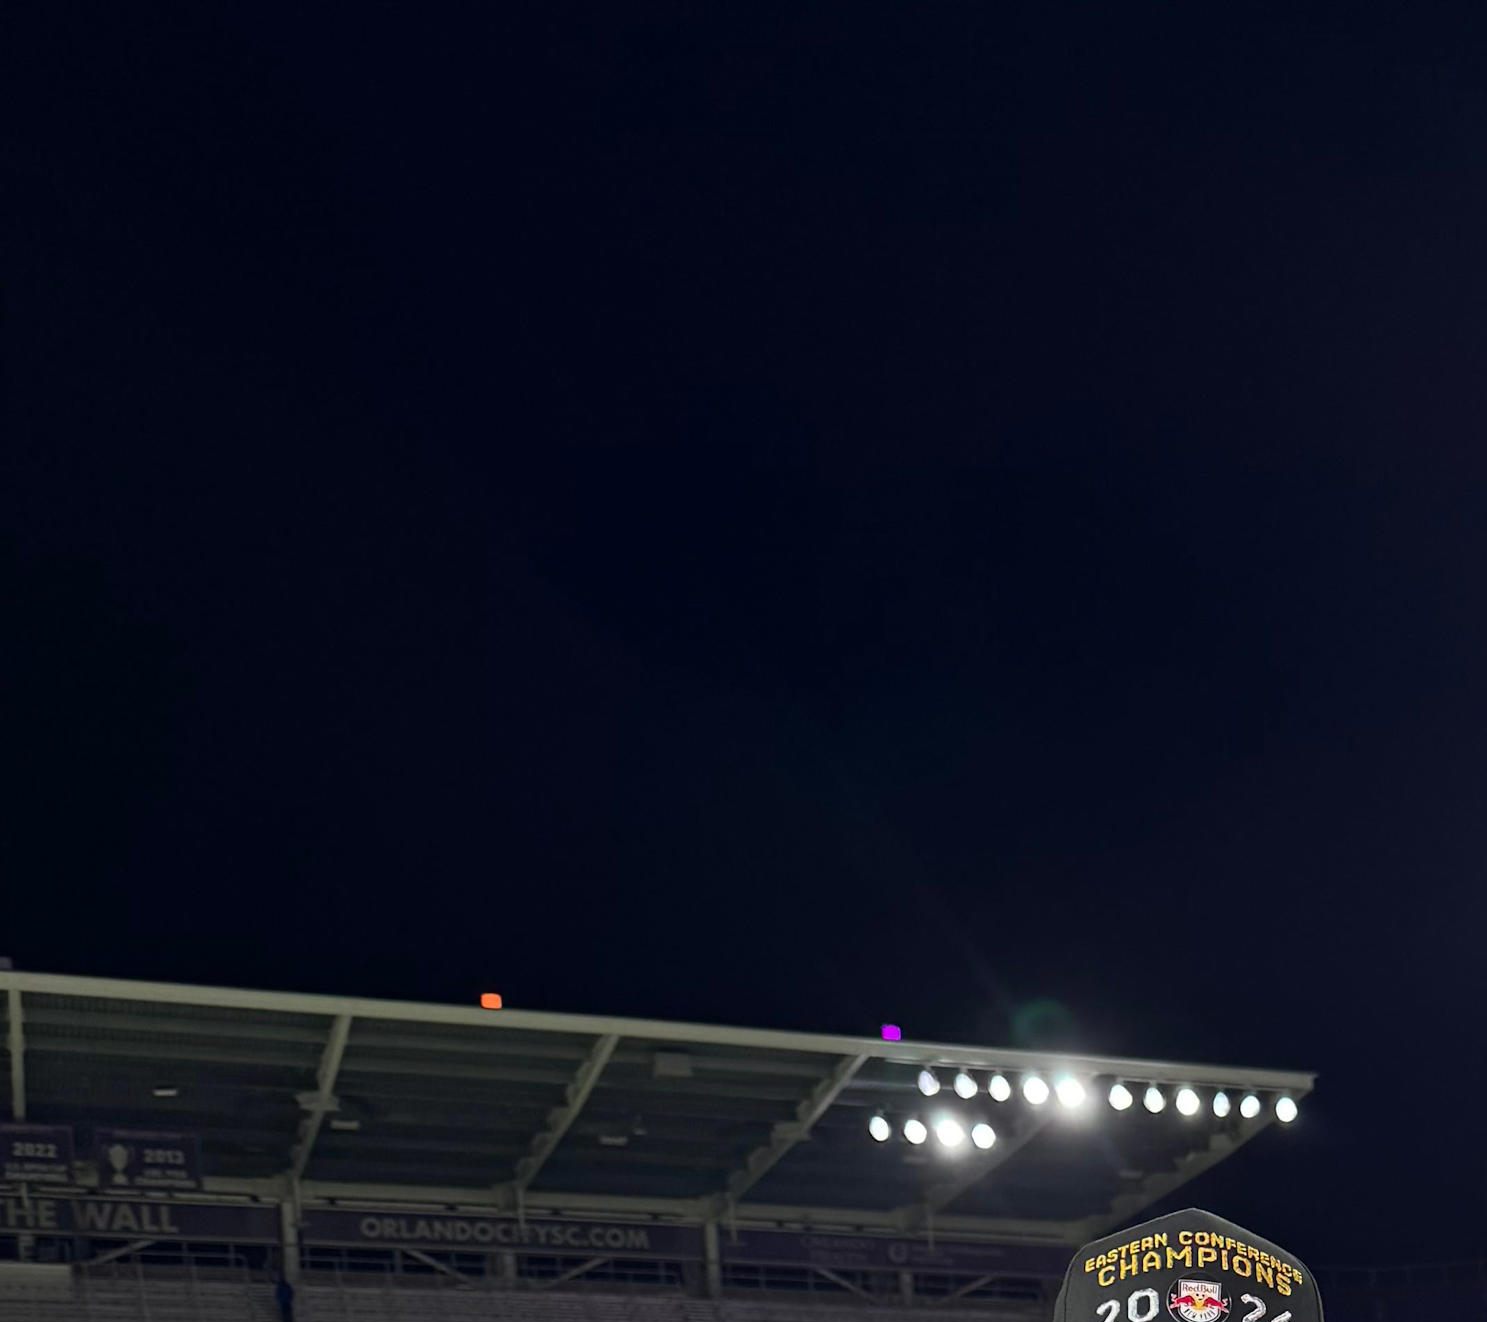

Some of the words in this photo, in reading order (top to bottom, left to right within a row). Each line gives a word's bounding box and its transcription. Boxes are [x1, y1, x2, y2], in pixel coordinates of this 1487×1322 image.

[72, 1202, 179, 1233] WALL
[1084, 1232, 1168, 1273] EASTERN
[1178, 1230, 1303, 1286] CONFERENCE
[1097, 1245, 1293, 1297] CHAMPIONS
